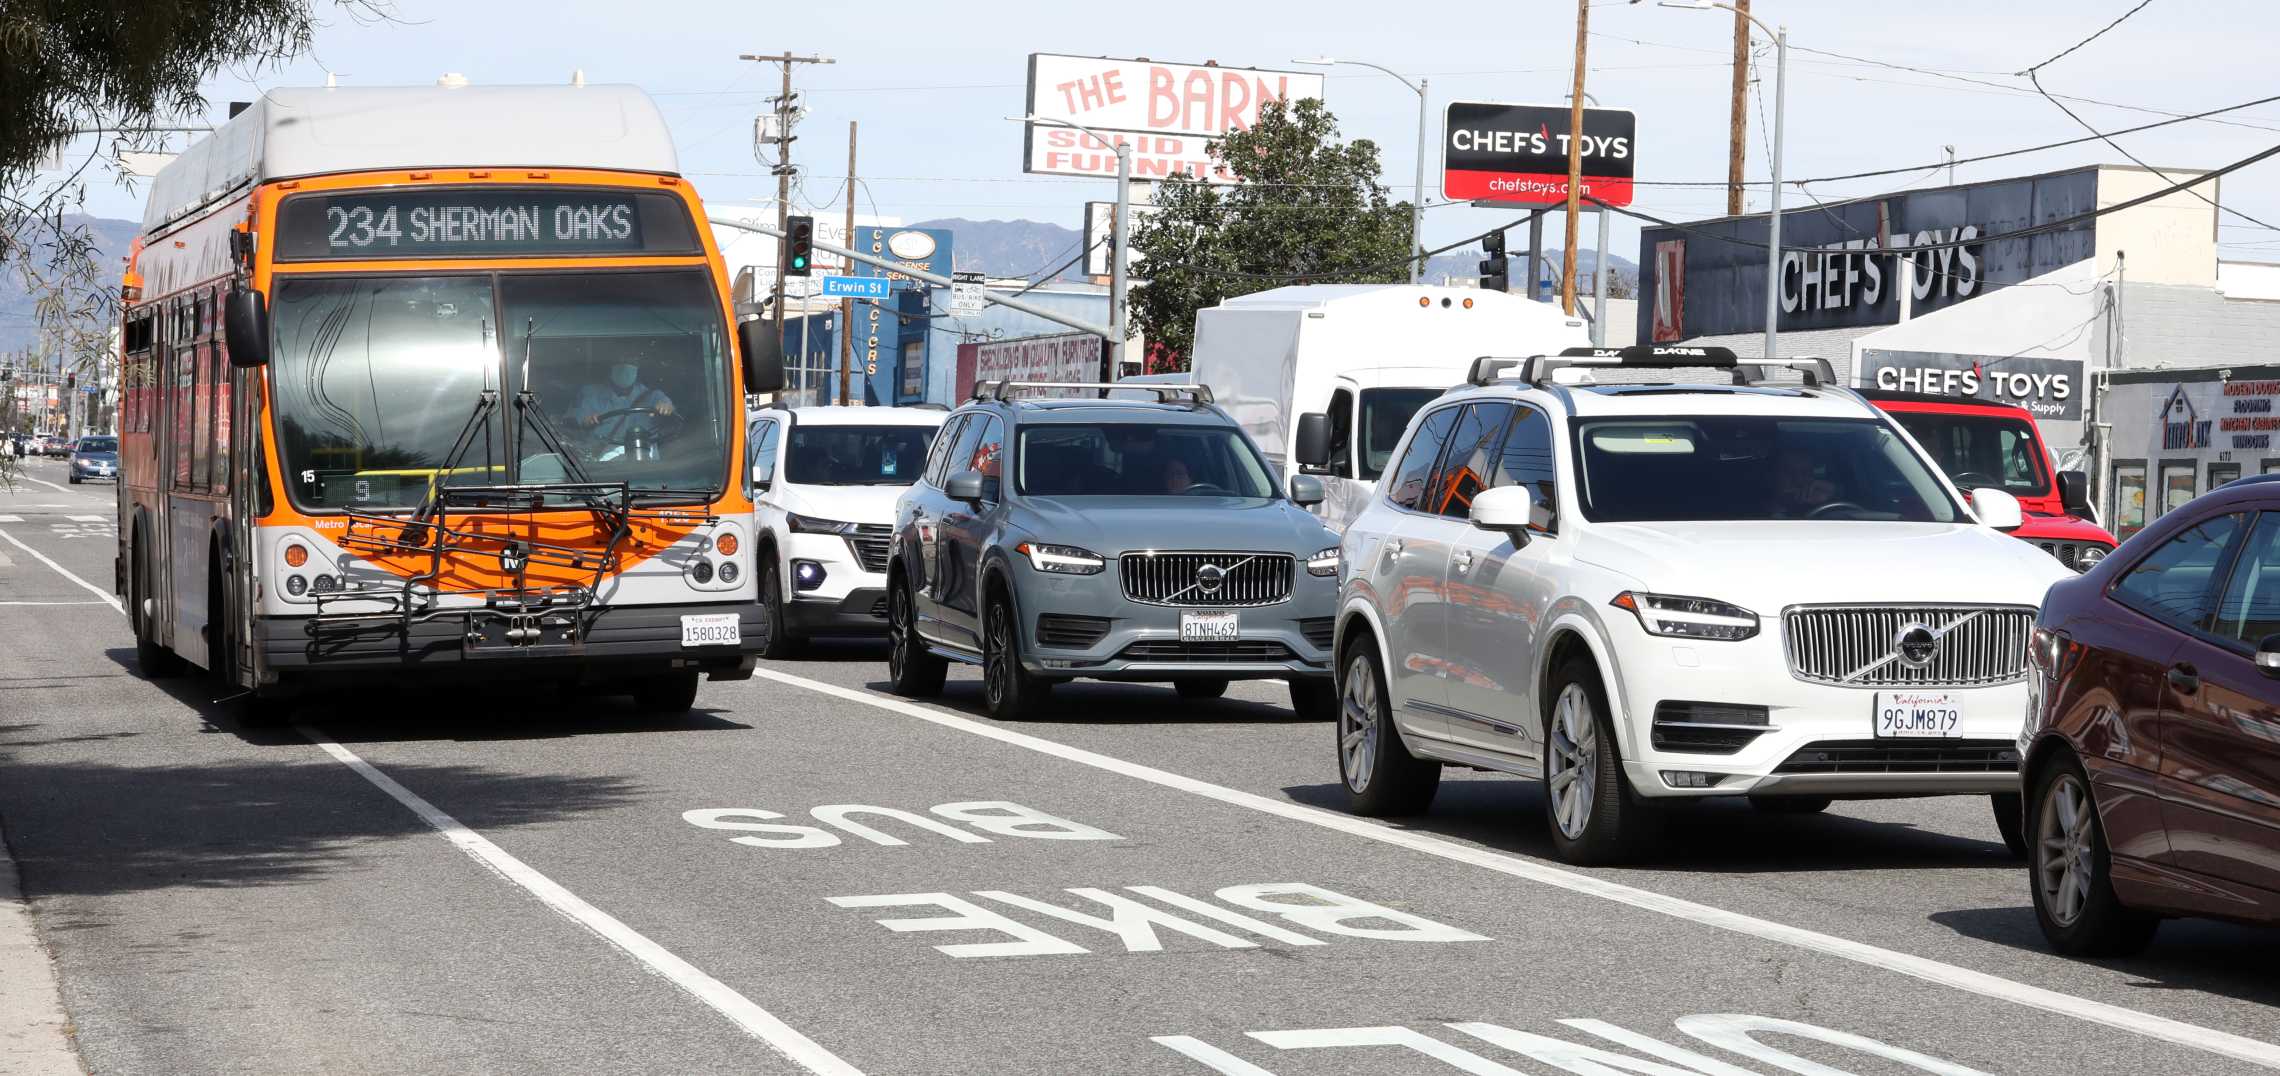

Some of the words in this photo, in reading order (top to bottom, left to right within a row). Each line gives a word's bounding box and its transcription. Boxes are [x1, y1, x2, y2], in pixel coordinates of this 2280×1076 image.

[1056, 69, 1127, 115] THE
[1147, 66, 1288, 133] BARN
[1556, 134, 1629, 159] TOYS
[1489, 178, 1591, 196] chefstoys.cm
[327, 205, 402, 246] 234
[411, 206, 540, 242] SHERMAN
[555, 204, 632, 241] OAKS
[1883, 225, 1979, 302] TOYS
[829, 280, 862, 293] Erwin
[869, 281, 882, 293] St
[1653, 347, 1706, 356] DAKINE
[1990, 371, 2071, 400] TOYS
[2031, 401, 2066, 415] Supply
[301, 470, 315, 483] 15
[315, 519, 345, 529] Metro
[685, 625, 737, 642] 1580328
[1185, 622, 1235, 637] 8TNH469
[1895, 694, 1948, 707] California
[1883, 708, 1957, 730] 9GJM879
[681, 800, 1127, 850] BUS
[822, 881, 1497, 959] BIKE
